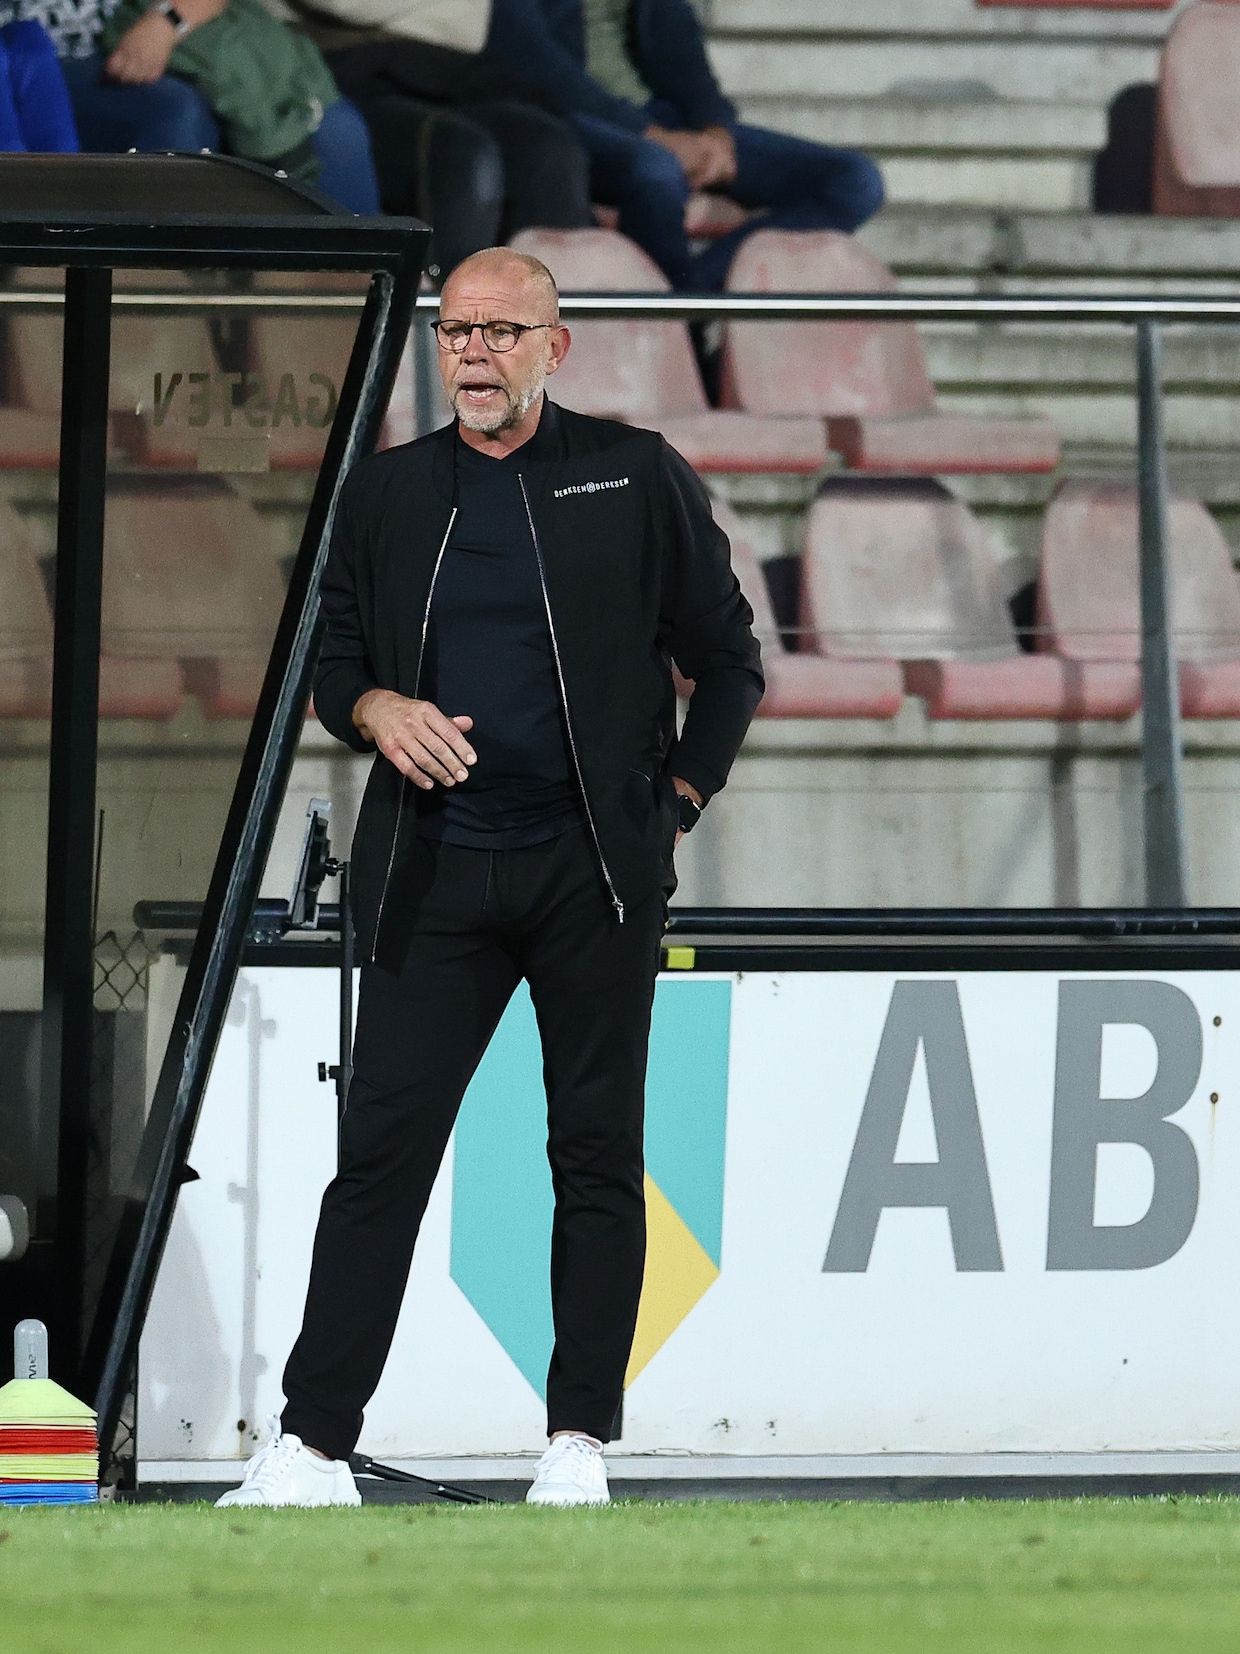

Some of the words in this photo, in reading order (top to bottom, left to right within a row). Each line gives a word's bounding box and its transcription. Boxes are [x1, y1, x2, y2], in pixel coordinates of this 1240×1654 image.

[554, 485, 587, 498] DERKSEN
[595, 477, 630, 491] DERKSEN
[821, 979, 1204, 1273] AB
